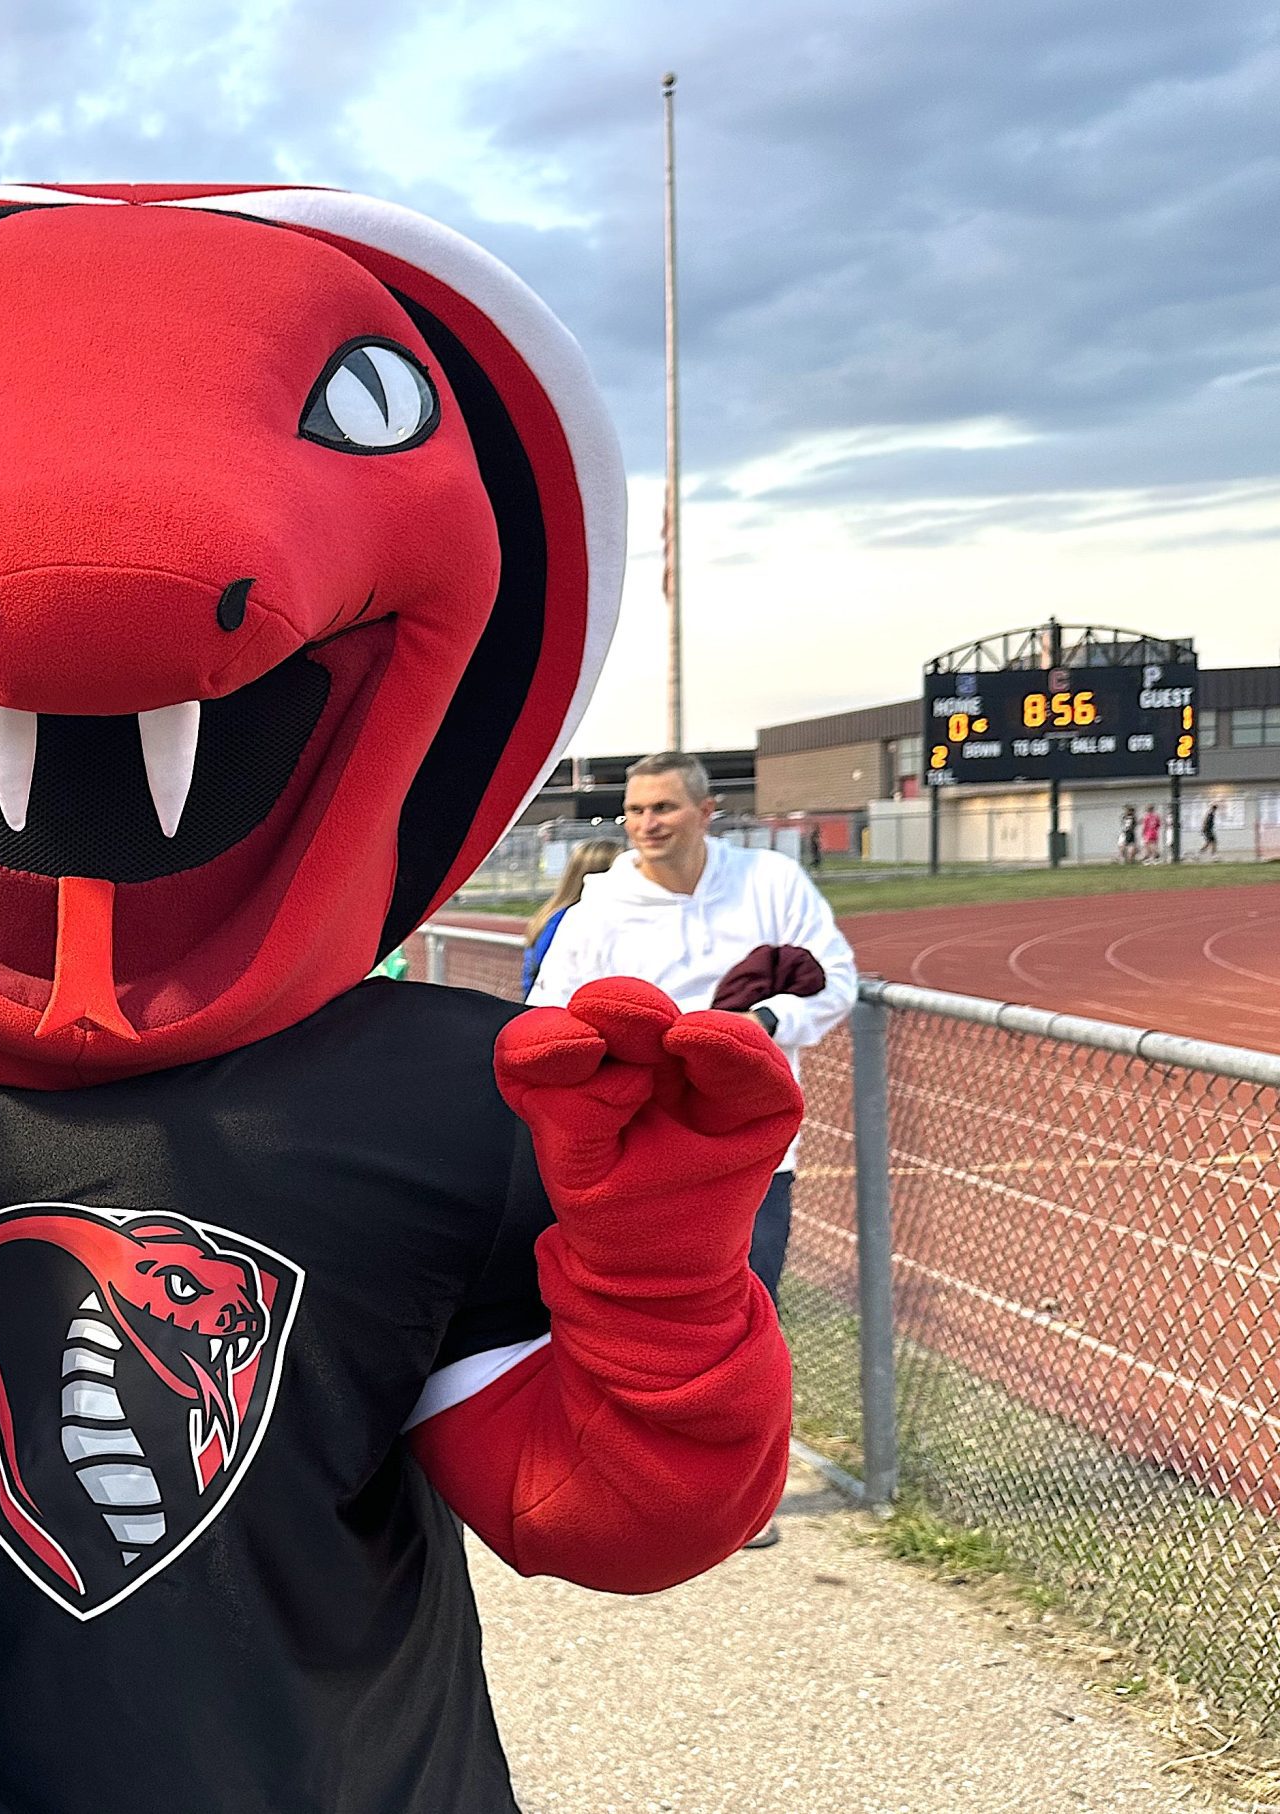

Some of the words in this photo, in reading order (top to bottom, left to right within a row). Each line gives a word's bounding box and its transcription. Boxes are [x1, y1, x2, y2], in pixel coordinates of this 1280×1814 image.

[932, 695, 982, 717] HOME
[1140, 687, 1194, 709] GUEST
[930, 745, 948, 769] 2
[1176, 734, 1194, 758] 2
